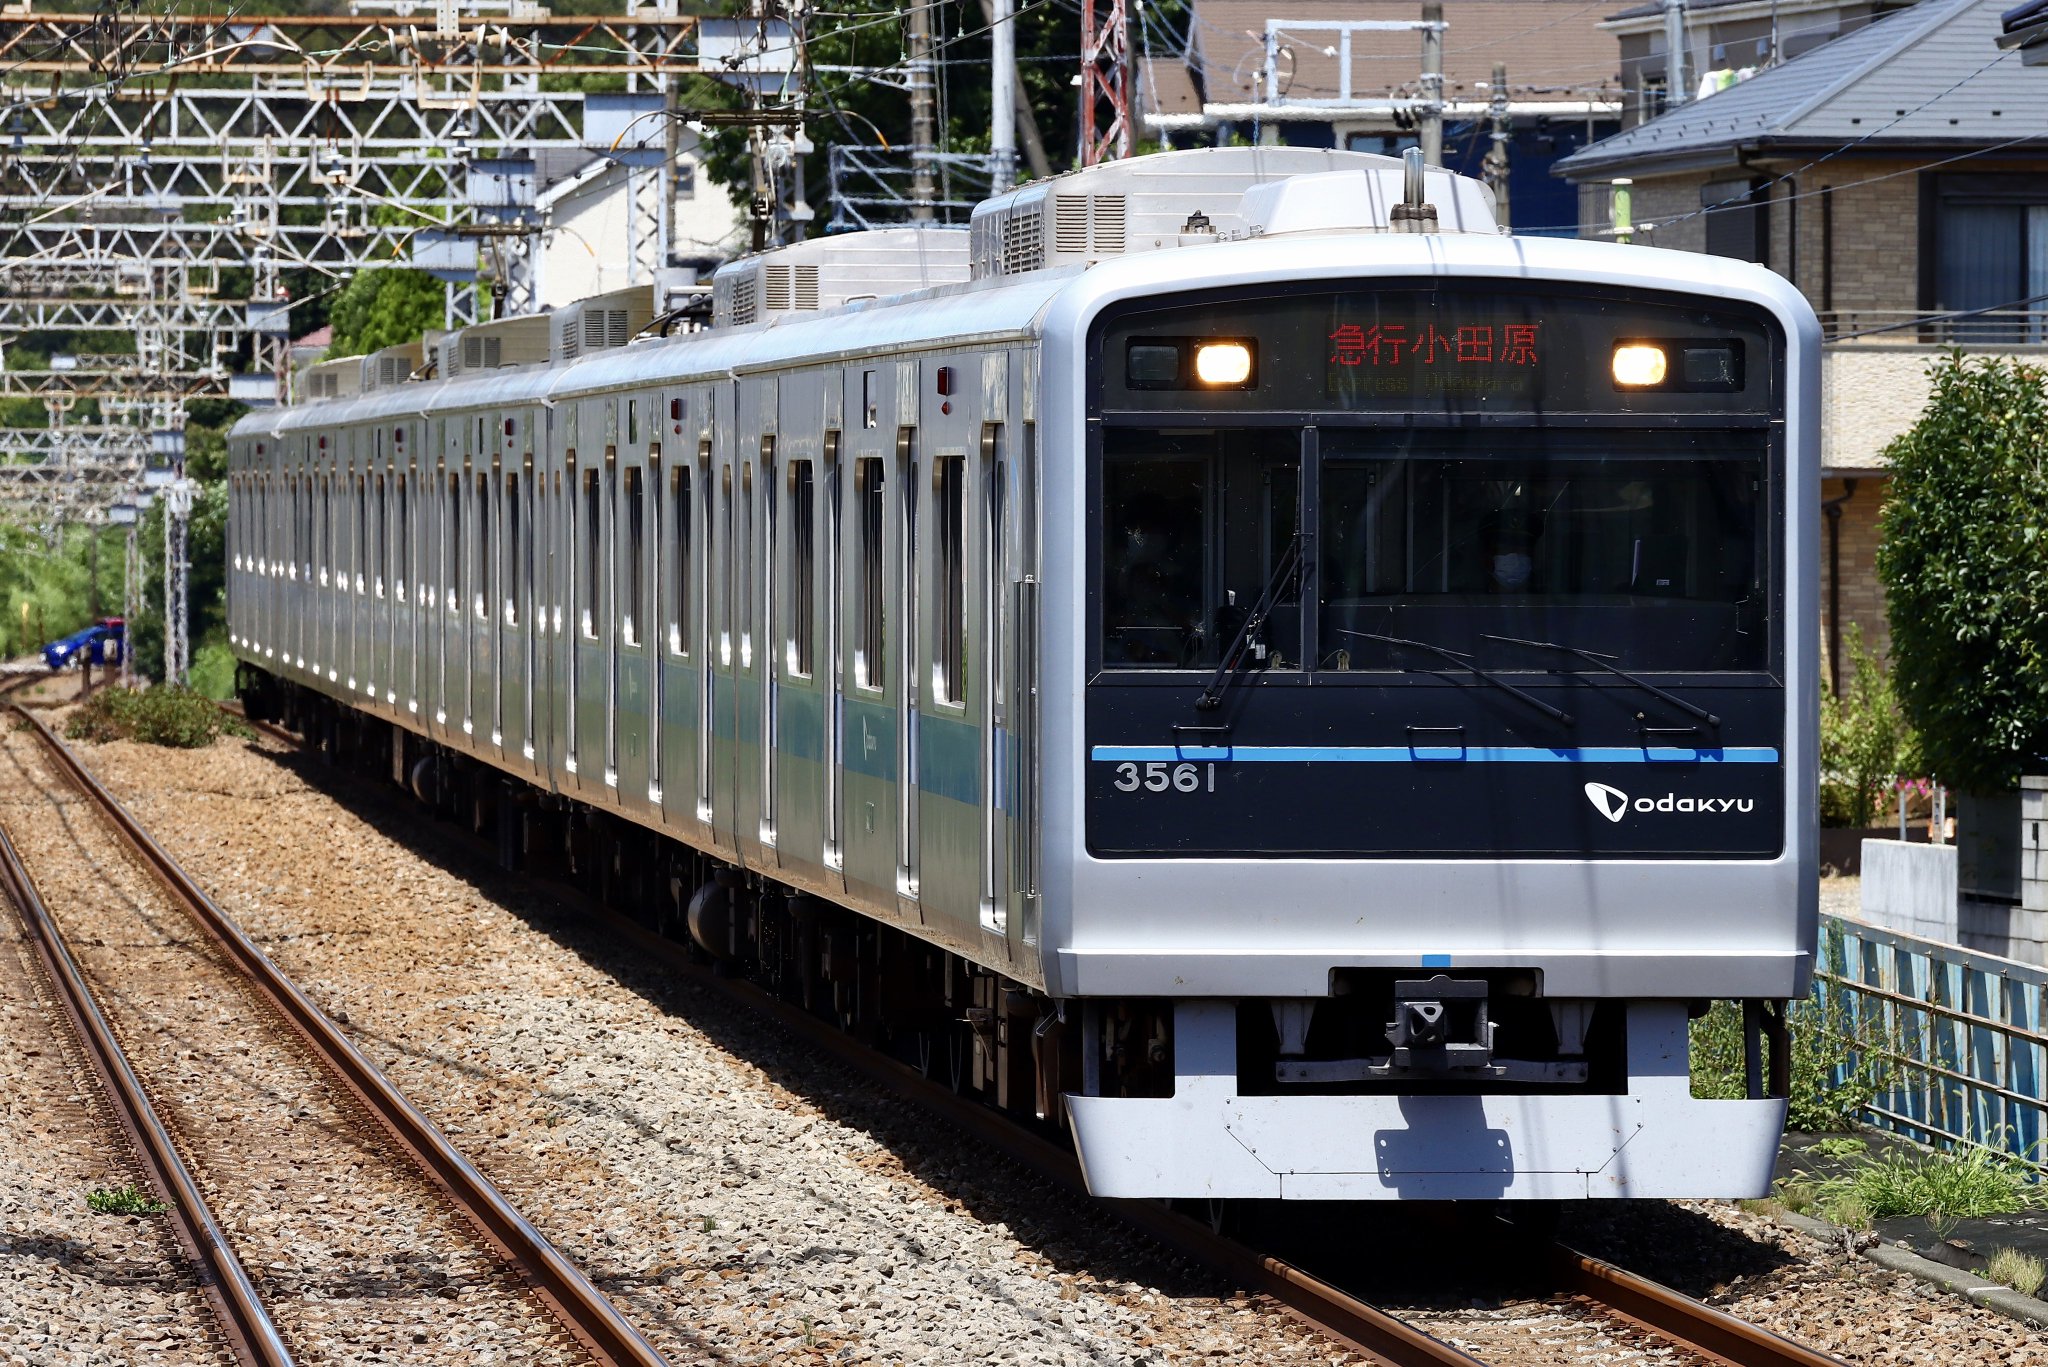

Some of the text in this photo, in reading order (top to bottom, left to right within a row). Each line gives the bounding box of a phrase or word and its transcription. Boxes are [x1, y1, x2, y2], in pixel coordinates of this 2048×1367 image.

[1328, 323, 1539, 365] 急行小田原
[1113, 762, 1215, 793] 3561
